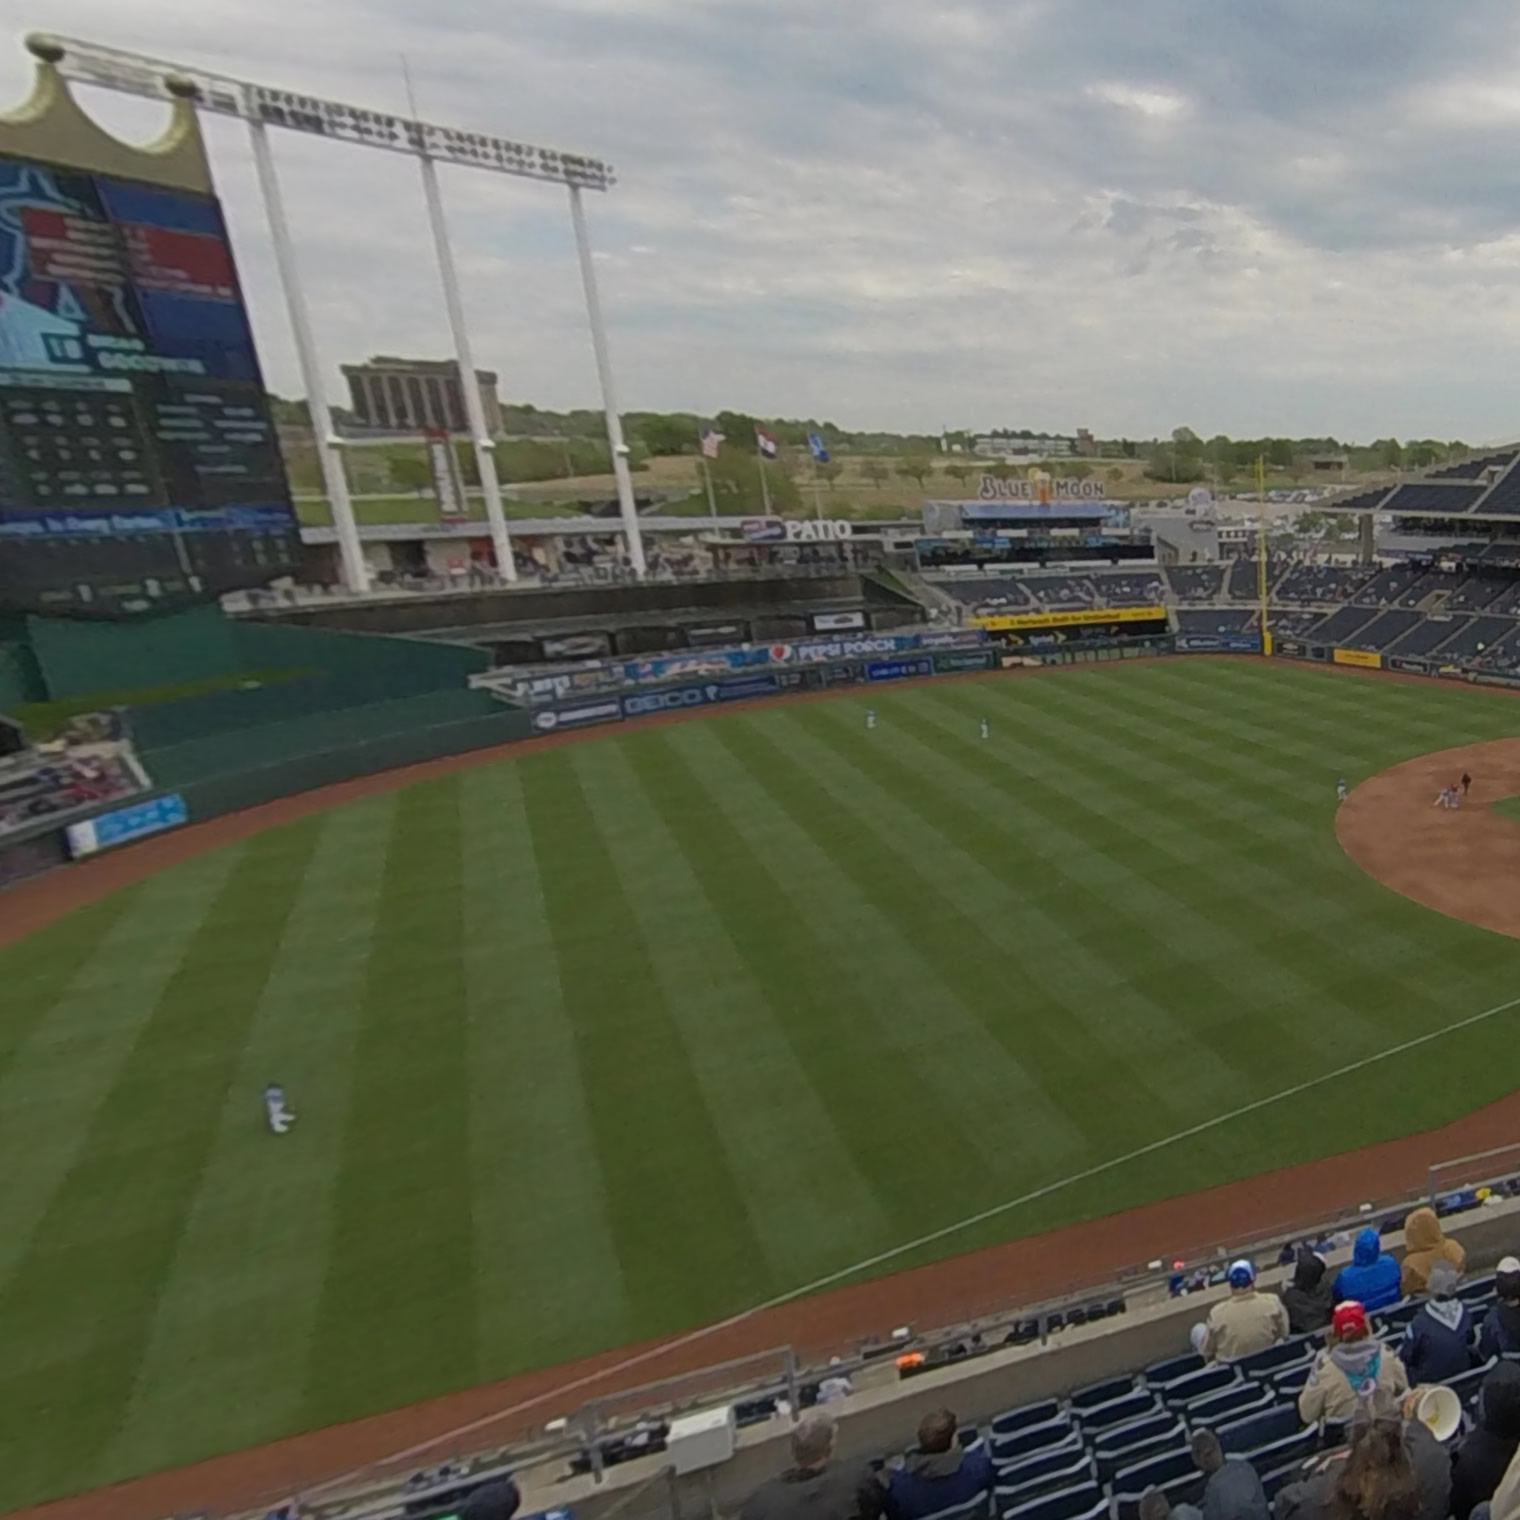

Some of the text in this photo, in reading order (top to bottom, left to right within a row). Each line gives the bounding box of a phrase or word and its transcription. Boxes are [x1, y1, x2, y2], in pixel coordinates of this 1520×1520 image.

[980, 475, 1105, 500] BLUE MOON
[784, 520, 852, 540] PATIO
[798, 639, 896, 658] PEPSI PORCH
[625, 688, 702, 714] GEICO
